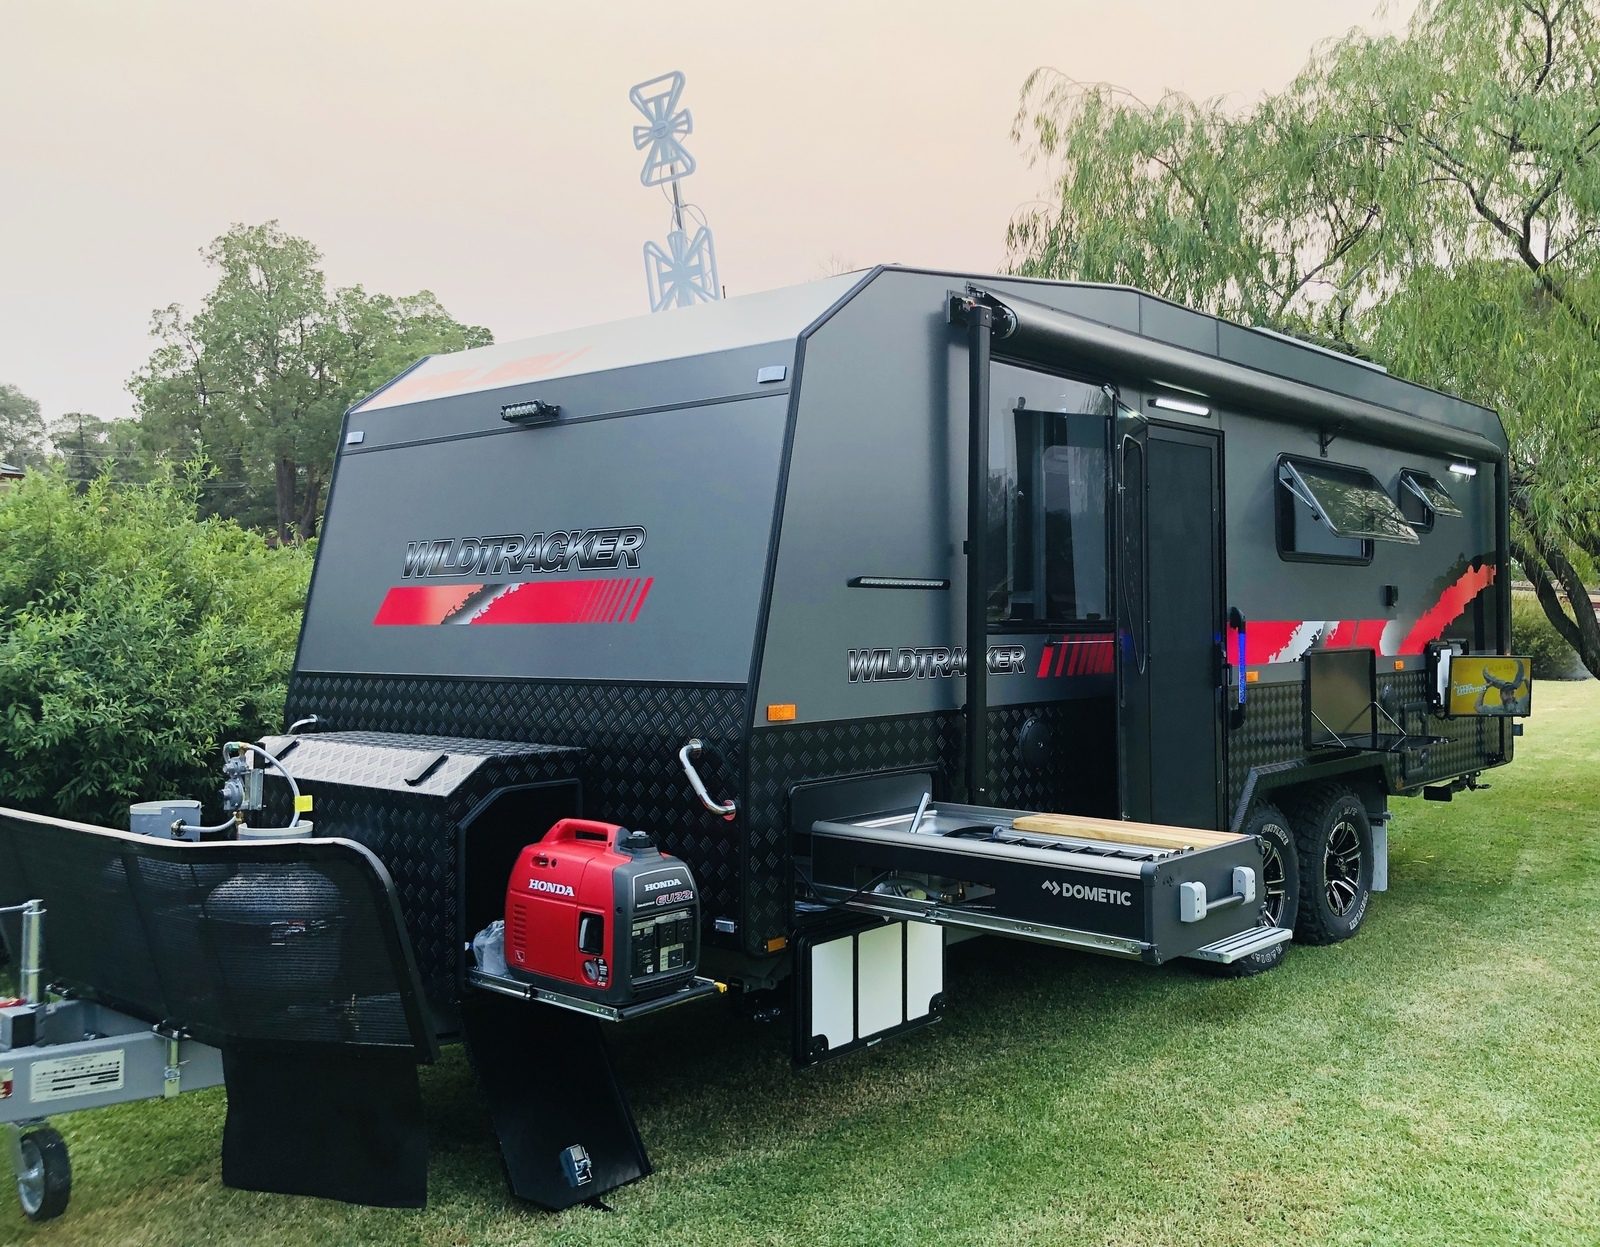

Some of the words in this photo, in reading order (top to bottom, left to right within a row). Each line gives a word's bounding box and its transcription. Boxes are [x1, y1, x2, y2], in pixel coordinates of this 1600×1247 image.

[401, 525, 647, 579] WILDTRACKER
[848, 645, 1025, 684] WILDTRAKER
[529, 879, 575, 897] HONDA
[645, 879, 682, 892] HONDA
[1062, 882, 1132, 906] DOMETIC
